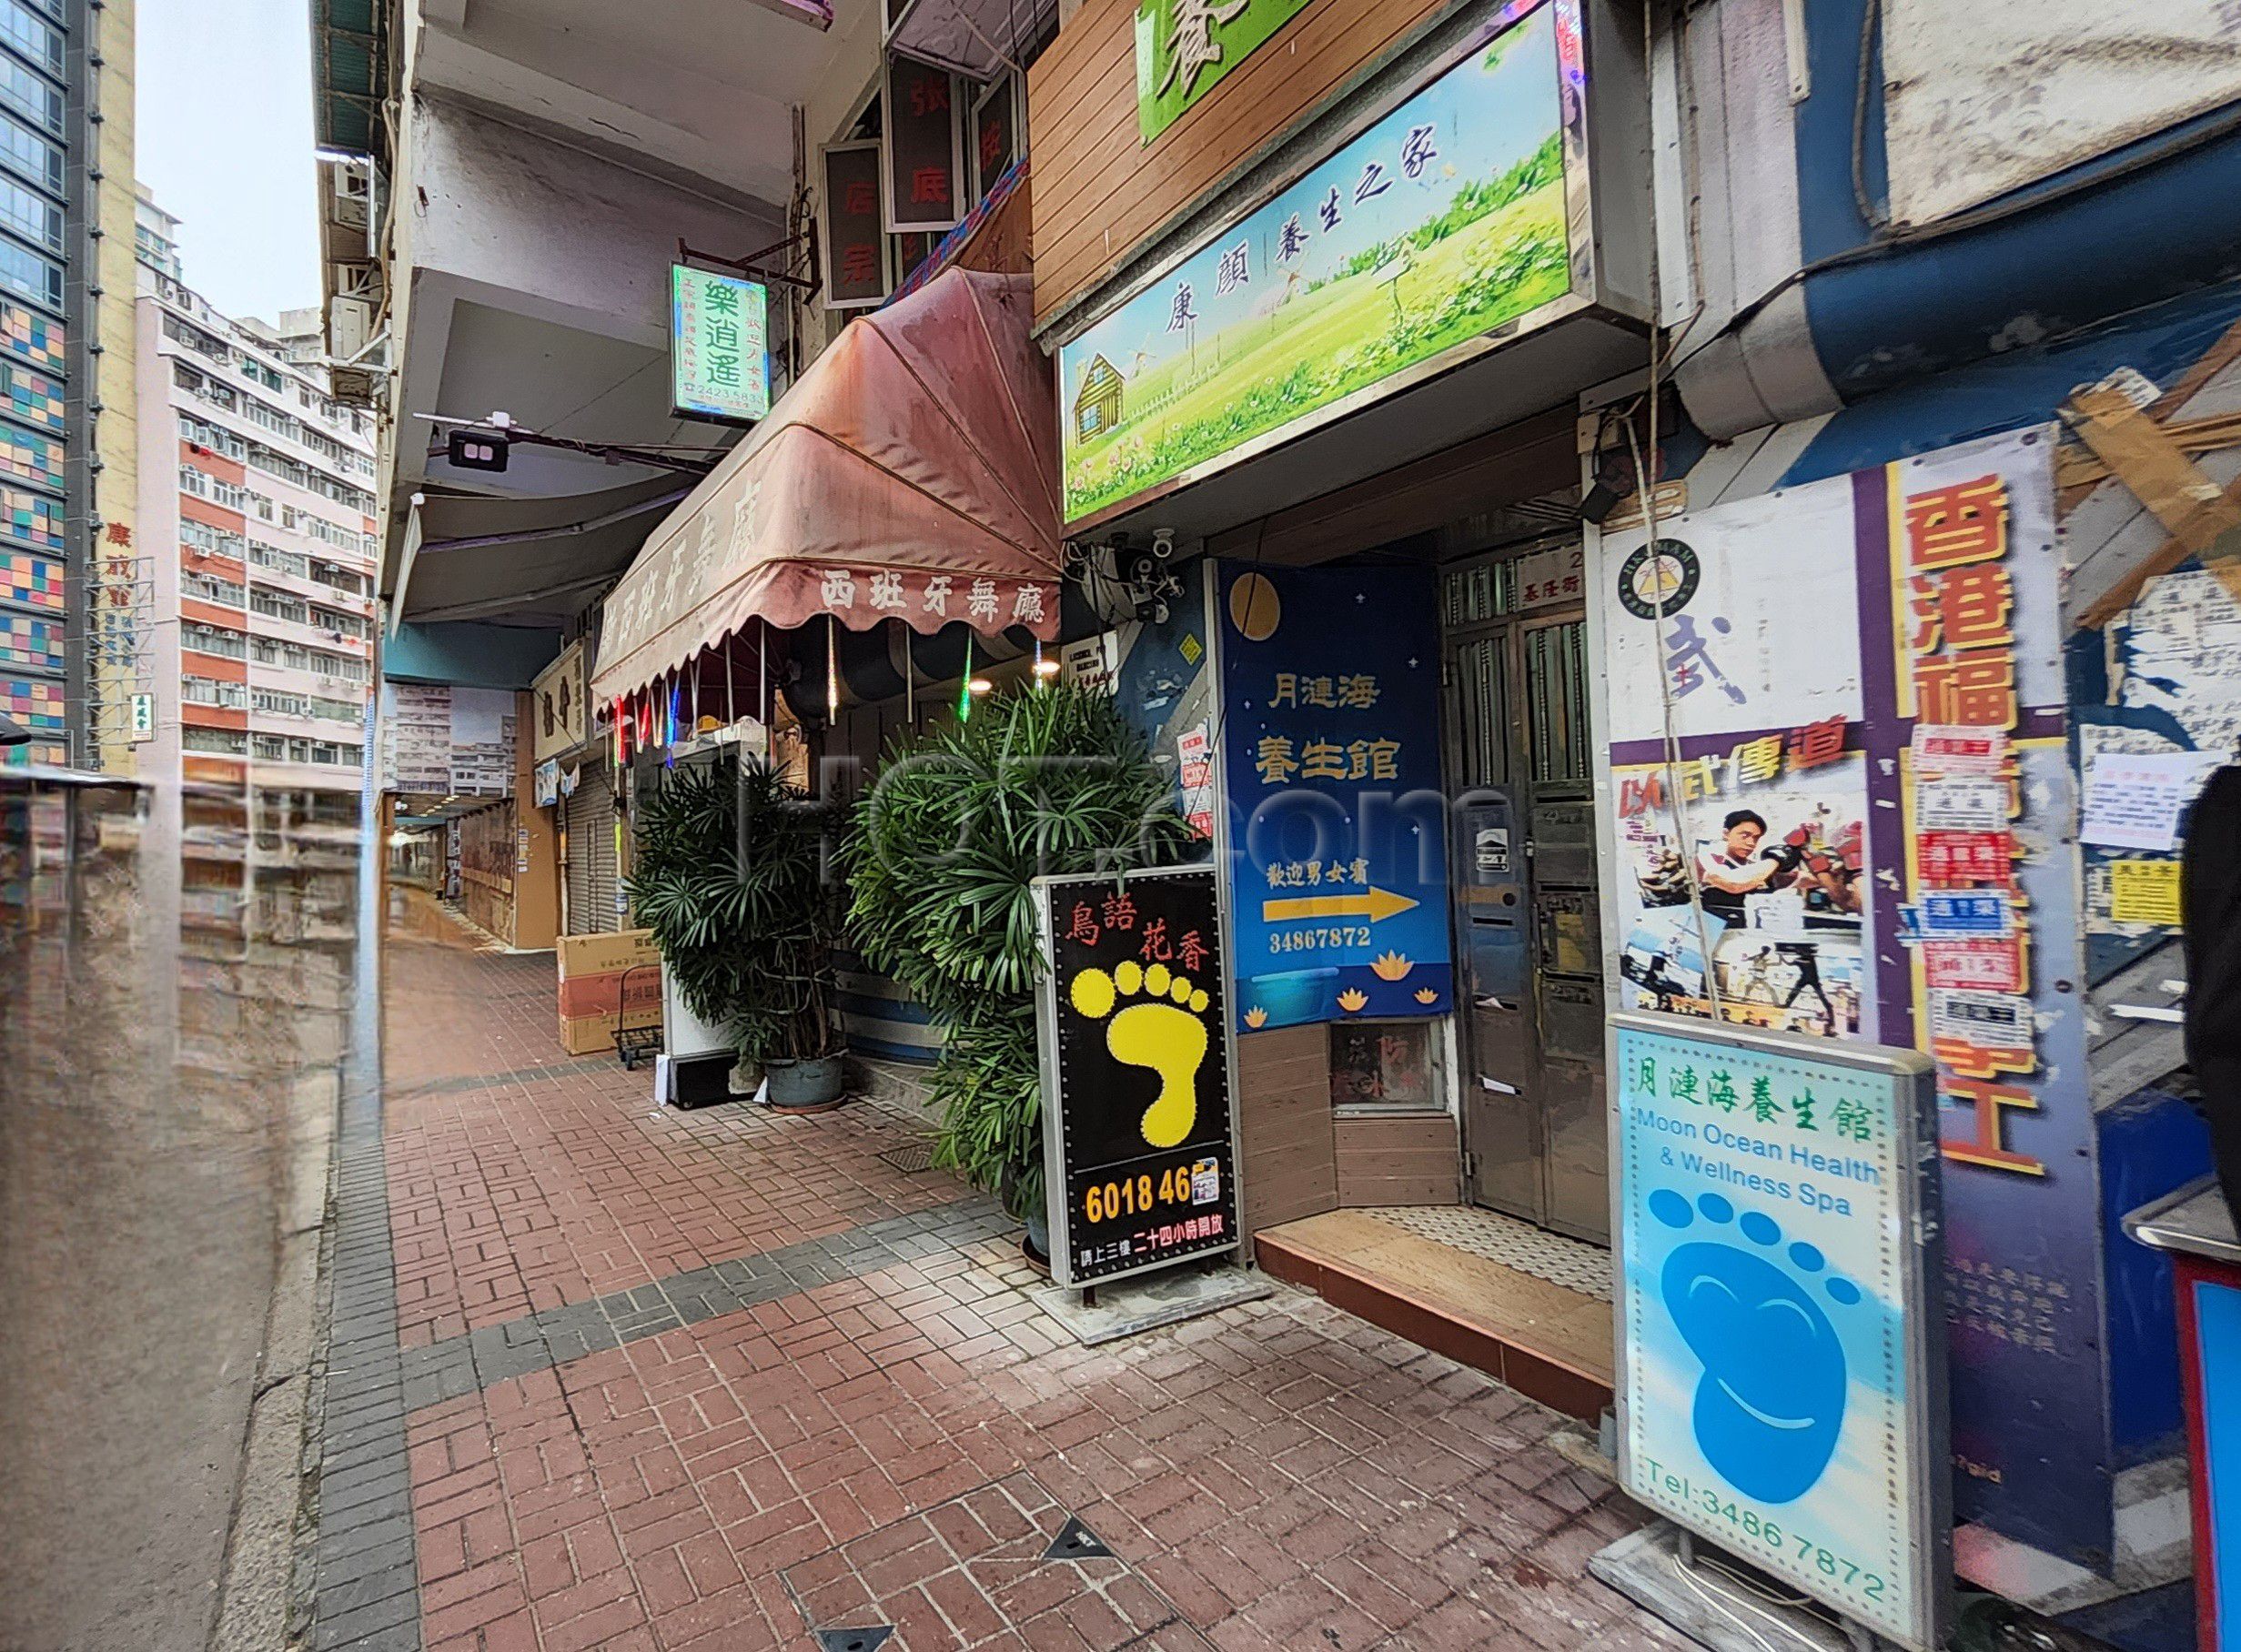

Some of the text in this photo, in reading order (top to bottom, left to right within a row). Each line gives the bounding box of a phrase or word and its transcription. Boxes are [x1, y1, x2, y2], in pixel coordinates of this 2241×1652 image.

[704, 280, 742, 388] 樂逍遙
[821, 569, 1045, 624] 西班牙舞廳
[1255, 735, 1401, 785] 養生館
[1065, 891, 1210, 972] 鳥語花香
[1268, 926, 1371, 954] 34867872
[1639, 1056, 1875, 1143] 月漣海養生館
[1638, 1107, 1882, 1186] Moon Ocean Health
[1661, 1146, 1853, 1217] & Wellness Spa
[1086, 1163, 1205, 1224] 6018 46
[1133, 1214, 1224, 1254] 二十四小時開放
[1792, 1534, 1887, 1604] 7872
